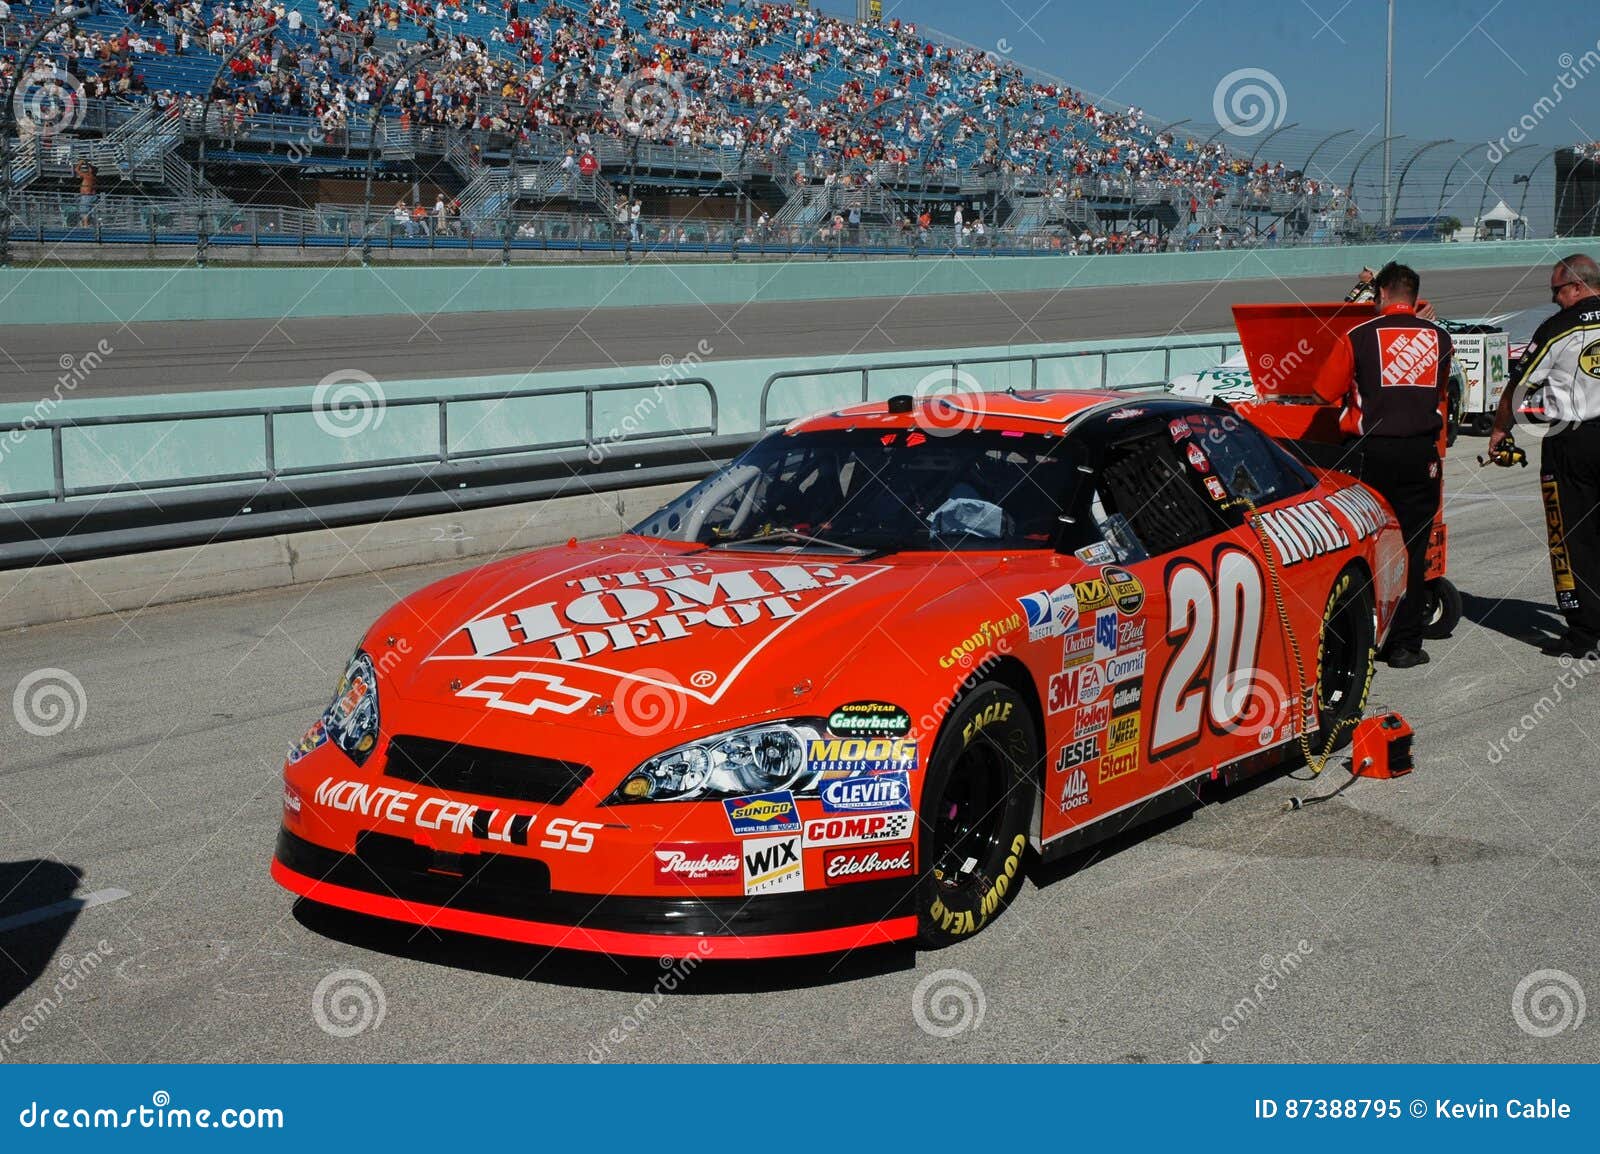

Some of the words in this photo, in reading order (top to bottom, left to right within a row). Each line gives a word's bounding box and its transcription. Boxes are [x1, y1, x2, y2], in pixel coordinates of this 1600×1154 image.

[1579, 310, 1600, 322] OFF
[1381, 328, 1438, 385] HOME
[1385, 333, 1411, 357] THE
[1403, 349, 1438, 385] DEPOT
[1257, 500, 1350, 566] HOME
[565, 563, 715, 593] THE
[462, 563, 862, 659] HOME
[549, 593, 804, 661] DEPOT
[1096, 612, 1117, 652] USG
[1118, 617, 1147, 642] Bud
[1065, 633, 1094, 653] Checkers
[1150, 542, 1266, 763] 20
[1081, 666, 1100, 689] EA
[1106, 651, 1145, 683] Commit
[1049, 670, 1078, 712] 3M
[1080, 687, 1100, 700] SPORTS
[1112, 687, 1141, 709] Gillette
[829, 713, 907, 729] Gatorback
[842, 704, 896, 713] GOODYEAR
[962, 702, 1013, 748] EAGLE
[1115, 728, 1138, 745] Meter
[1117, 717, 1135, 732] Auto
[808, 740, 916, 761] MOOG
[1056, 737, 1100, 772] JESEL
[812, 760, 866, 770] CHASSIS
[875, 760, 913, 770] PARTS
[1100, 746, 1138, 781] Stant
[827, 780, 900, 804] CLEVITE
[1062, 768, 1089, 799] MAC
[314, 777, 418, 824] MONTE
[540, 818, 604, 853] SS
[735, 803, 790, 818] SUNOCO
[1061, 794, 1089, 812] TOOLS
[807, 816, 887, 841] COMP
[861, 829, 900, 840] CAMS
[655, 850, 741, 878] Raybestos
[745, 839, 799, 877] WIX
[826, 850, 912, 878] Edelbrock
[747, 870, 801, 894] FILTERS
